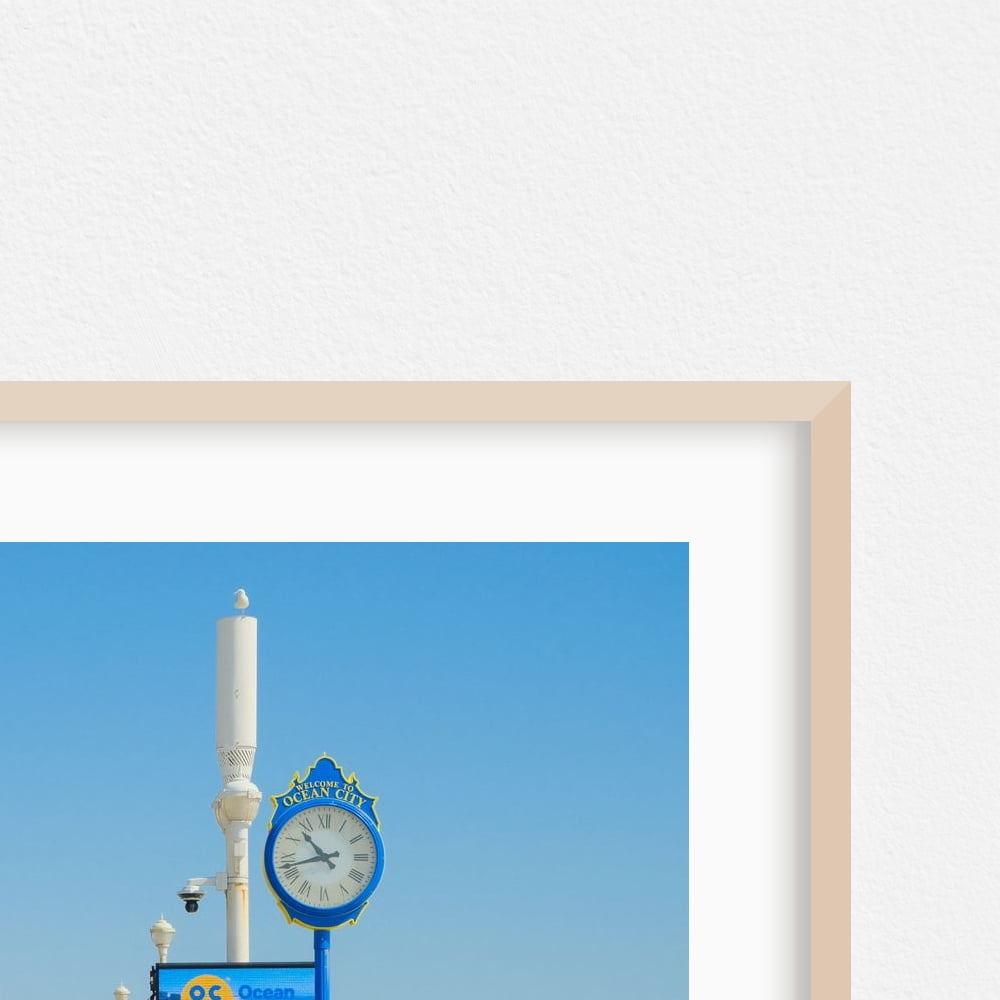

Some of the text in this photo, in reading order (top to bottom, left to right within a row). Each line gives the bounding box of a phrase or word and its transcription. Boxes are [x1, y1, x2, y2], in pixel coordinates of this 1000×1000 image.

[296, 780, 354, 792] WELCOME TO
[282, 787, 366, 808] OCEAN CITY
[318, 814, 331, 828] XII
[338, 820, 347, 832] I
[349, 834, 364, 845] II
[354, 854, 368, 862] III
[238, 984, 295, 999] Ocean
